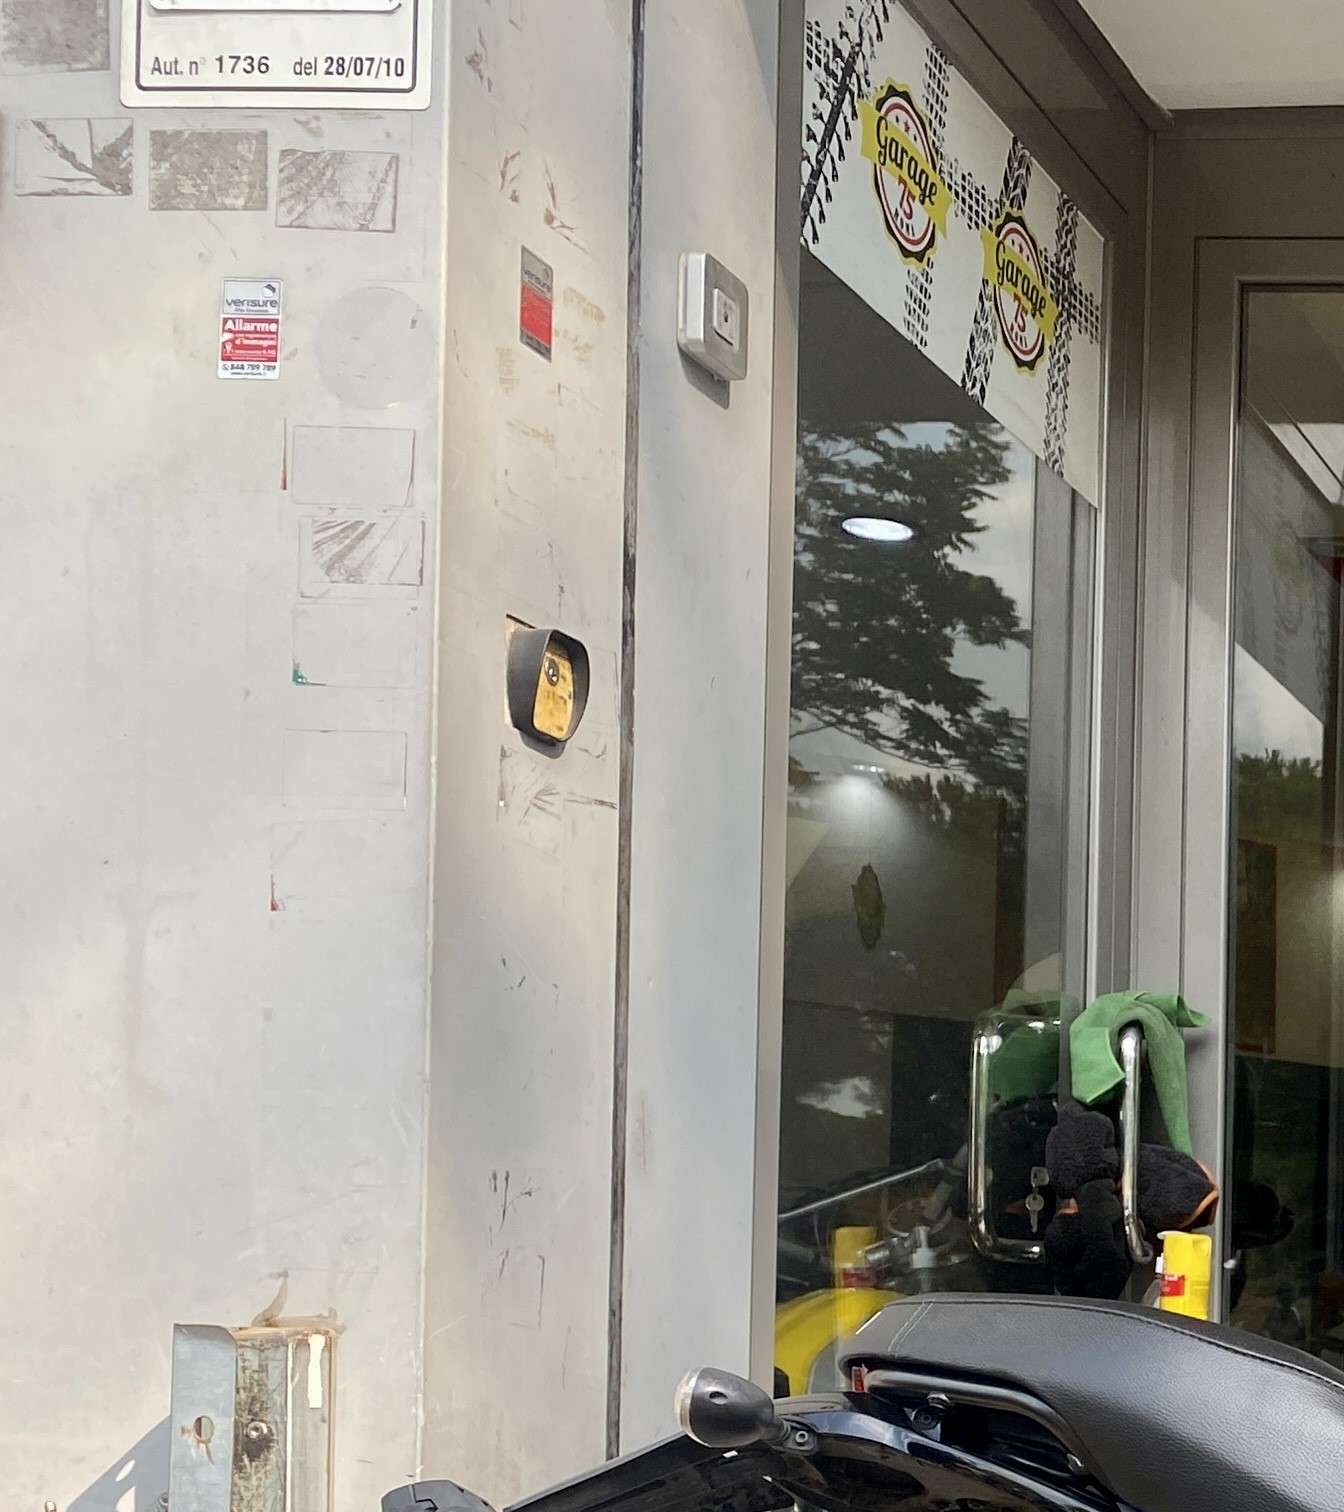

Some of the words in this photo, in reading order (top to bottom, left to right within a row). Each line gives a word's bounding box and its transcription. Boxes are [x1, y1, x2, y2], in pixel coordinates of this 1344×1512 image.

[151, 56, 183, 76] Aut.
[215, 55, 270, 74] 1736
[293, 57, 317, 76] del
[323, 56, 405, 78] 28/07/10
[876, 116, 938, 206] Garage
[996, 240, 1047, 319] Garage
[224, 319, 278, 332] Allarme
